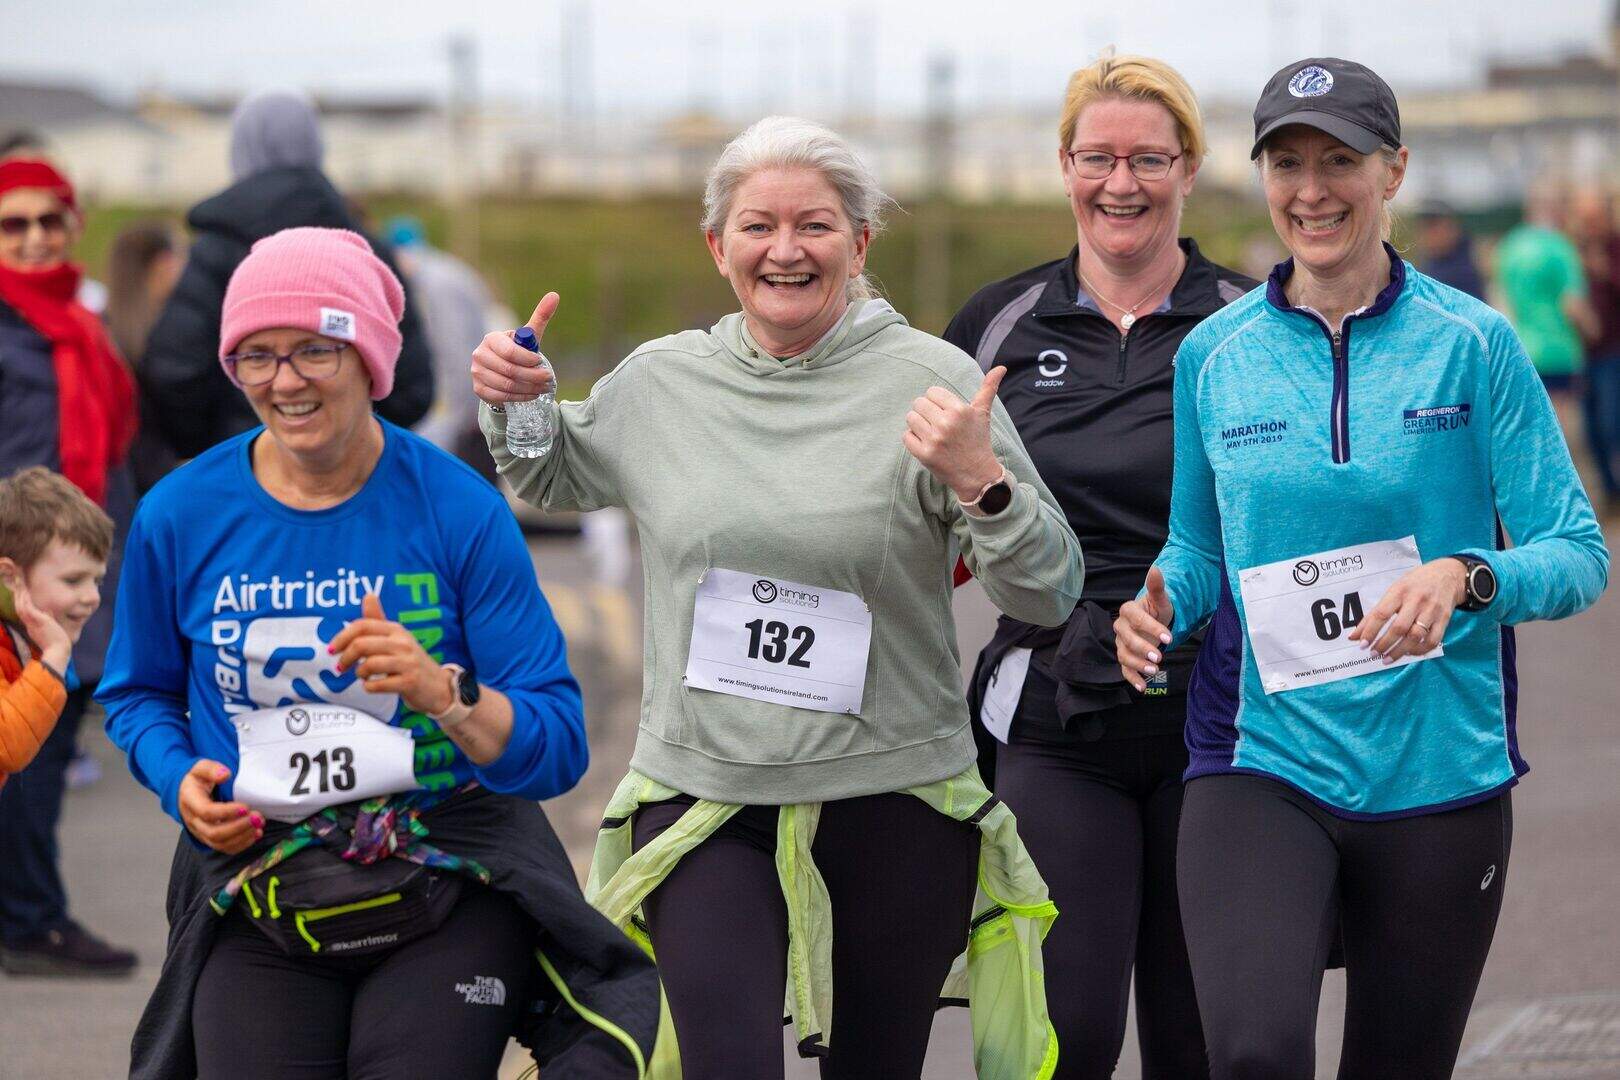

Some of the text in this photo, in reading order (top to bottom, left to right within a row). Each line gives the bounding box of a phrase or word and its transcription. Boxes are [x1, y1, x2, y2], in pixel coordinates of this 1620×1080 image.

[1034, 378, 1065, 387] shadow
[1403, 412, 1469, 432] GREAT RUN
[1416, 406, 1460, 418] REGENERON
[1221, 420, 1287, 441] MARATHON
[1226, 434, 1283, 450] MAY 5TH 2019
[1320, 554, 1364, 571] timing
[213, 567, 386, 614] Airtricity
[780, 586, 819, 608] timing
[1310, 591, 1365, 641] 64
[744, 618, 816, 669] 132
[717, 676, 829, 702] www.timingsolutionsireland.com
[1144, 687, 1168, 695] RUN
[289, 746, 356, 797] 213
